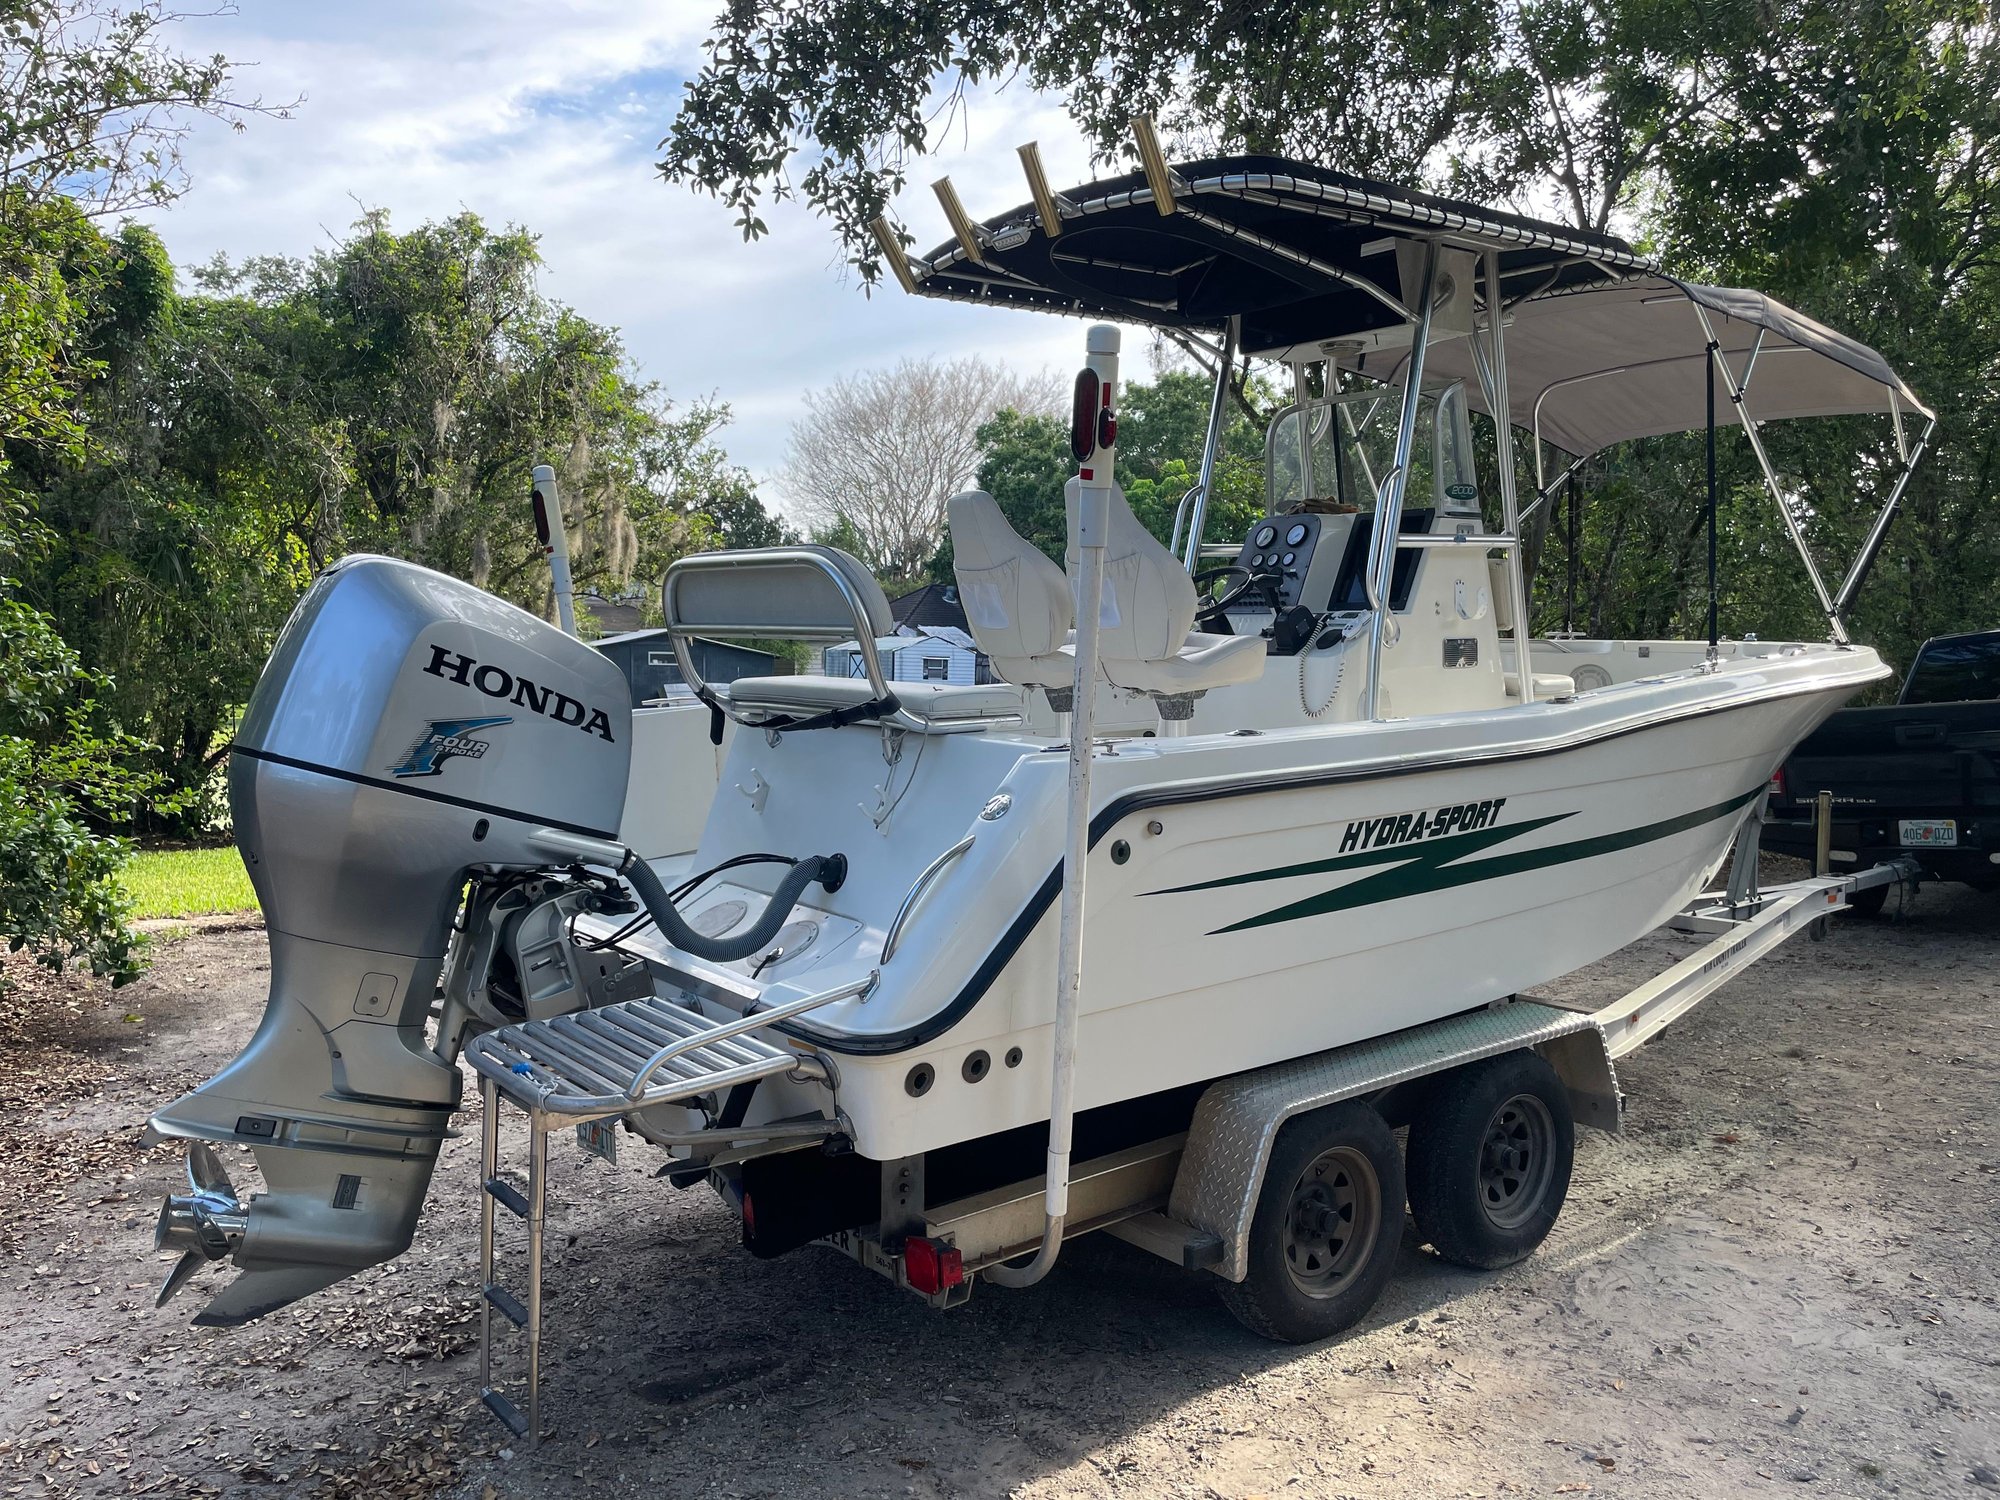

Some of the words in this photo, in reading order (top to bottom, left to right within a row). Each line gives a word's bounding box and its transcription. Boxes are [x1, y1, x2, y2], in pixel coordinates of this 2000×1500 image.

[1452, 486, 1474, 495] 2000
[423, 643, 616, 744] HONDA
[429, 734, 489, 752] FOUR
[435, 745, 483, 758] STROKE
[1338, 797, 1507, 853] HYDRA-SPORT
[1903, 827, 1922, 840] 406
